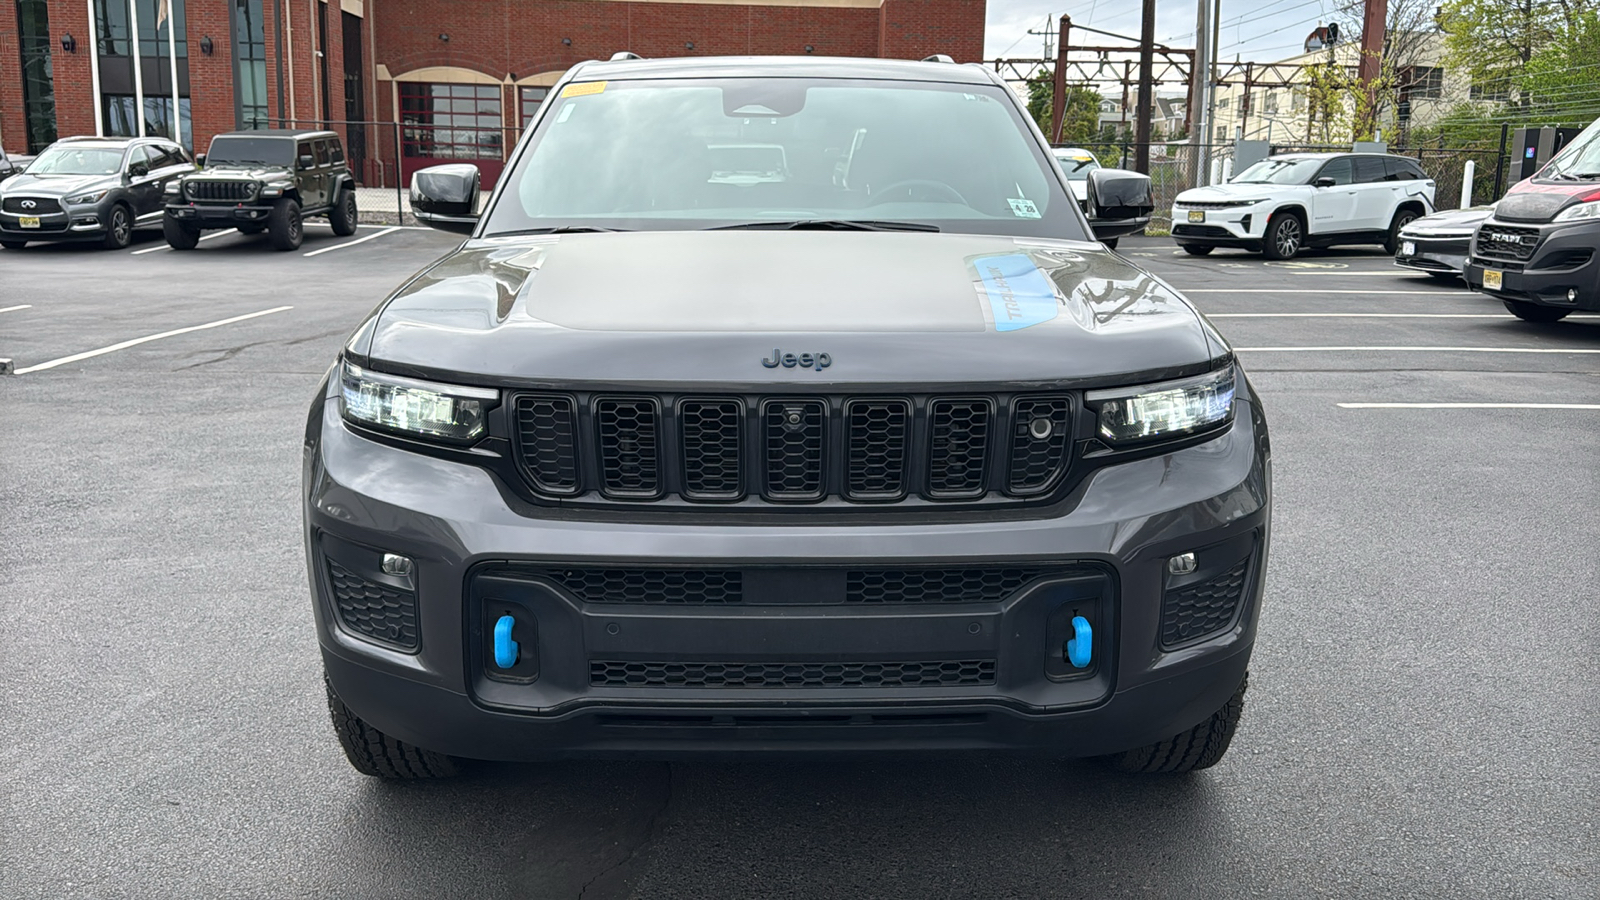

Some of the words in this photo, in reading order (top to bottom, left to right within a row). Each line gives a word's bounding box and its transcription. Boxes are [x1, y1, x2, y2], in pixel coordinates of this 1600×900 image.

[1024, 205, 1035, 213] 28
[1491, 233, 1521, 244] RAM
[761, 348, 832, 371] Jeep
